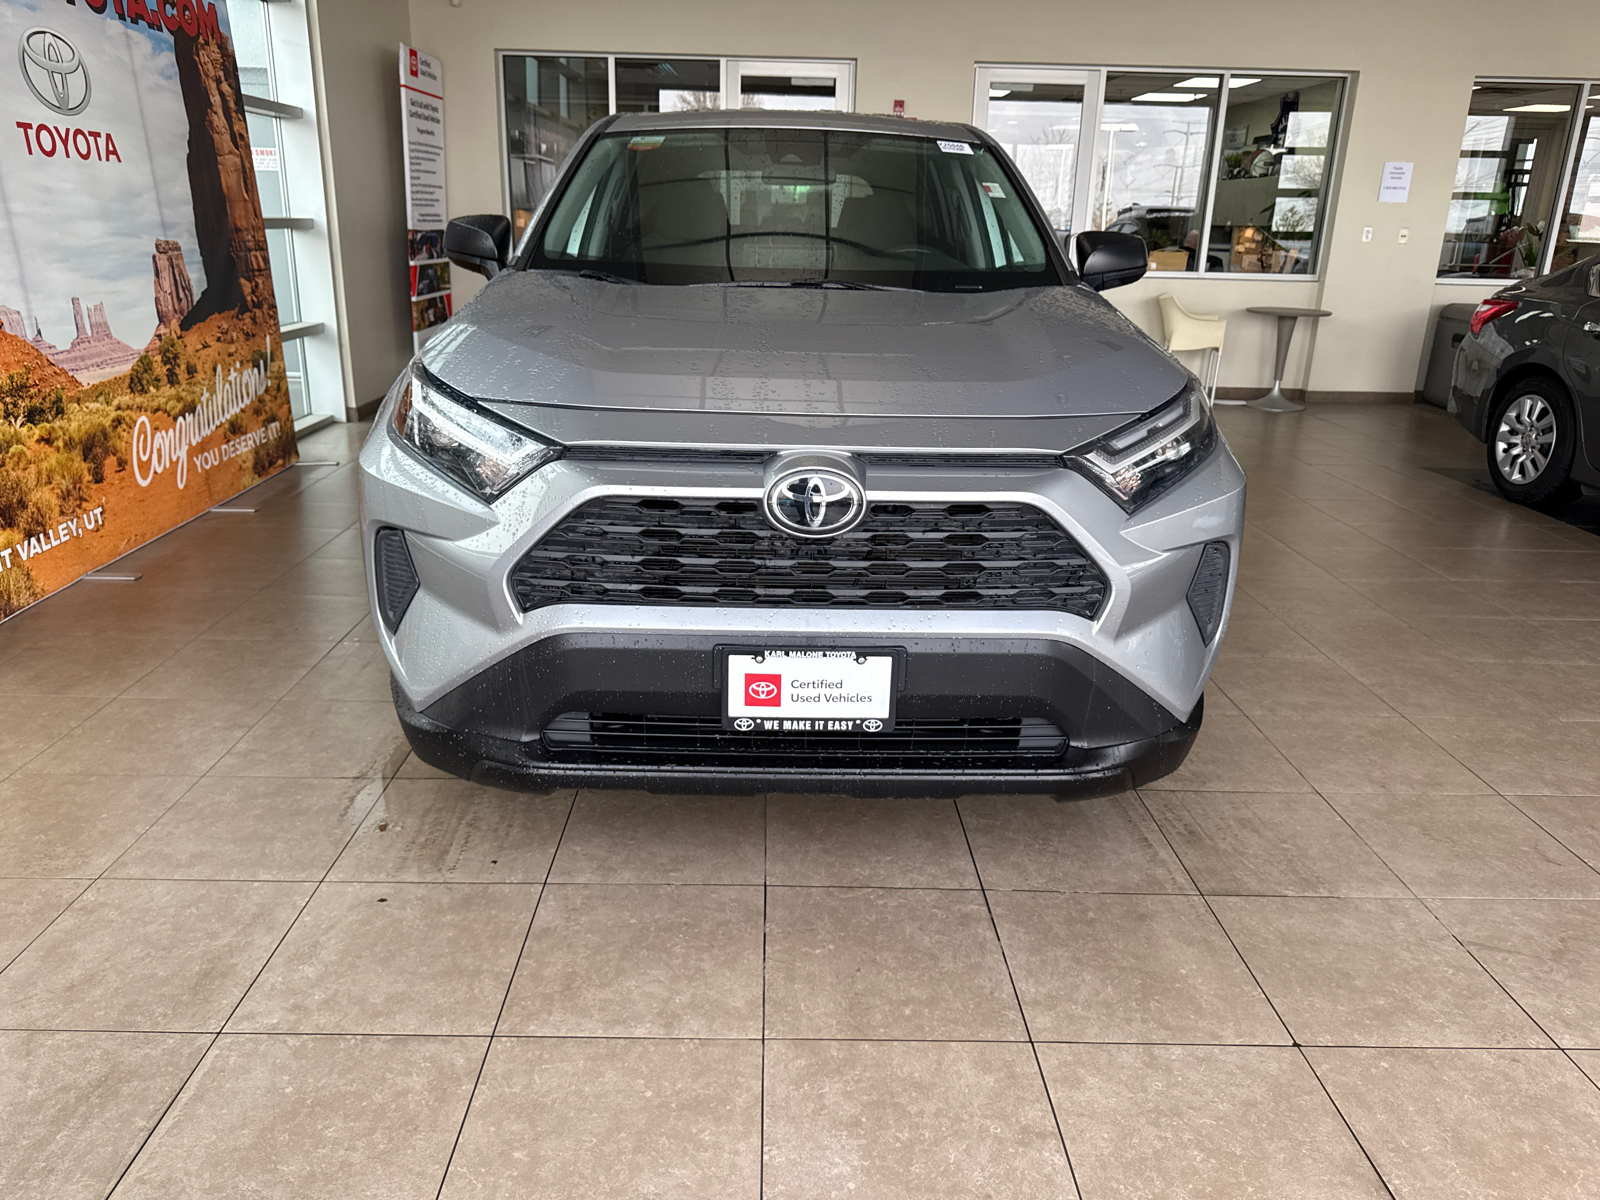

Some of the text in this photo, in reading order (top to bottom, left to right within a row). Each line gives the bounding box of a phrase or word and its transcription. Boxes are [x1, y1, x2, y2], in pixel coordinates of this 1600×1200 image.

[15, 121, 122, 163] TOYOTA
[133, 334, 272, 490] Congratulations!
[193, 421, 282, 473] YOU DESERVE IT!
[15, 517, 83, 561] VALLEY,
[83, 506, 103, 530] UT
[764, 650, 857, 659] KARL MALONE TOYOTA
[790, 679, 843, 689] Certified
[790, 693, 873, 703] Used Vehicles
[763, 720, 853, 731] WE MAKE IT EASY
